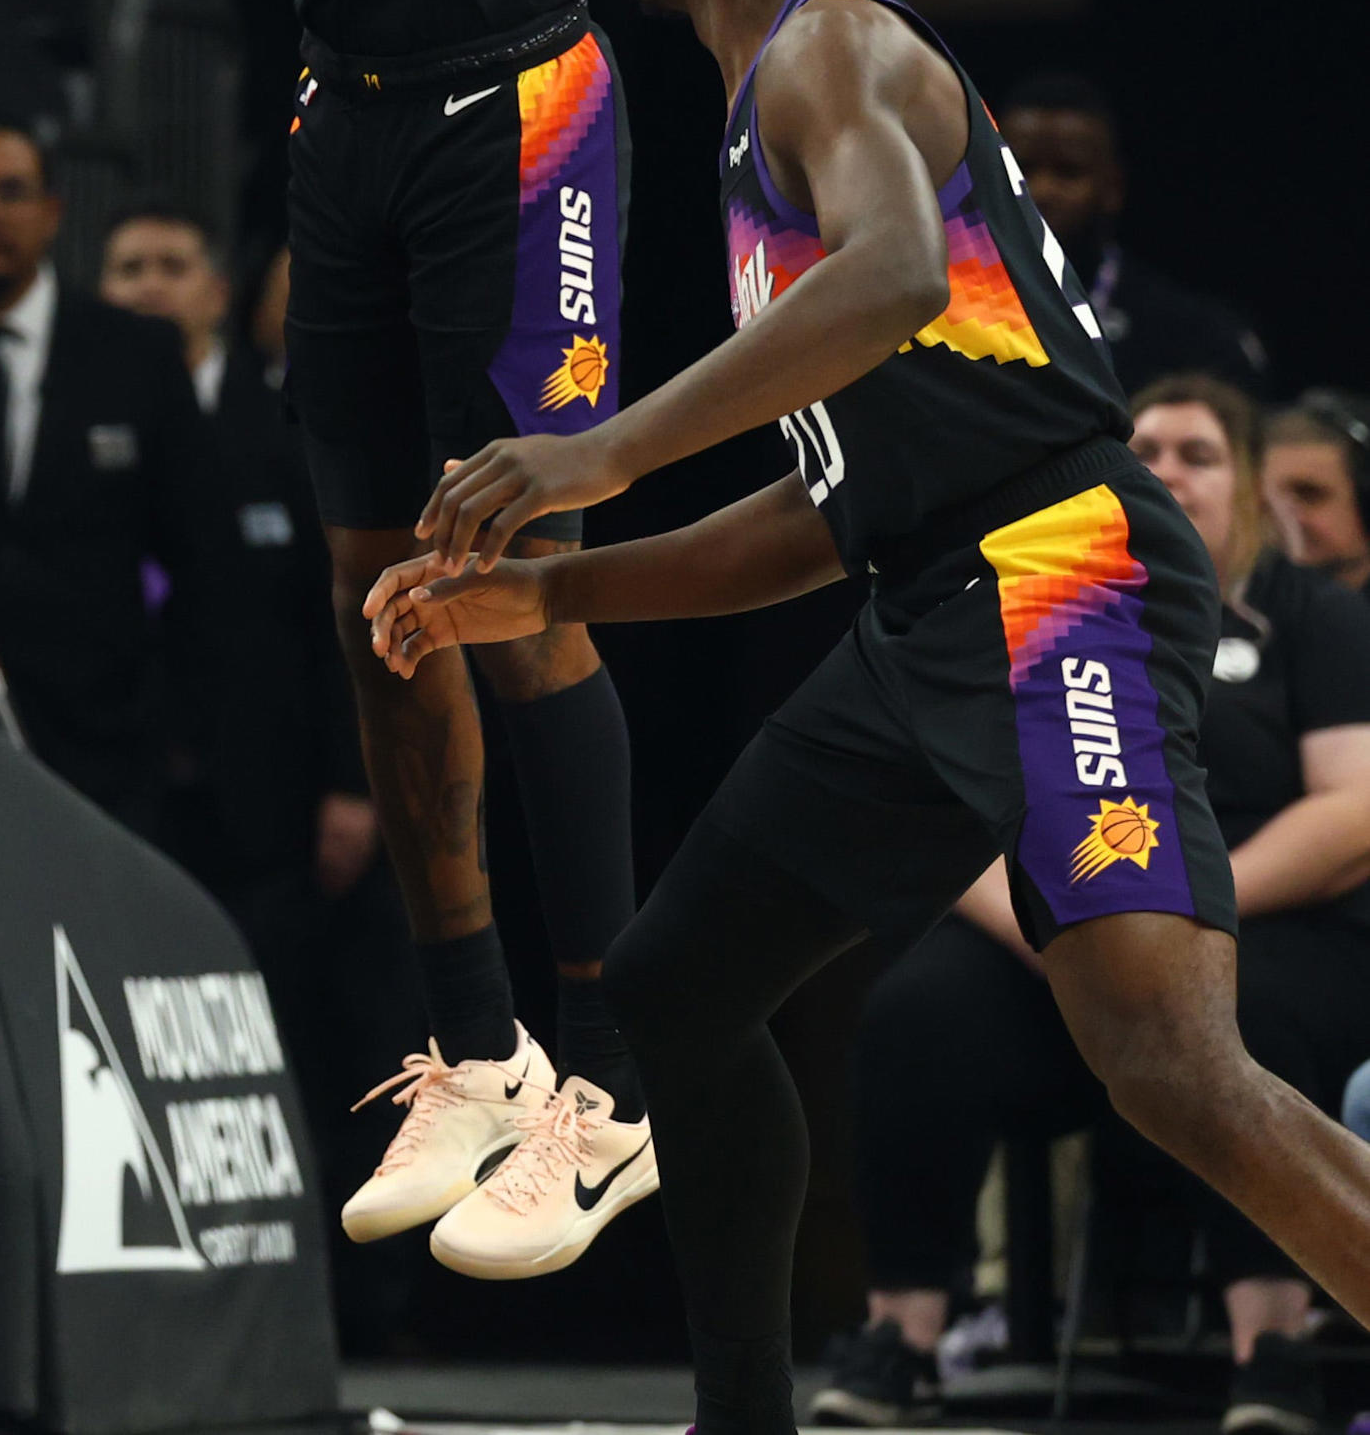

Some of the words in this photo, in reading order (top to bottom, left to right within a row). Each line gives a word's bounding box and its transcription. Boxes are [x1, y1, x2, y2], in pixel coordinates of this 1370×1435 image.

[559, 185, 597, 325] SUNS
[1061, 656, 1128, 788] SUNS
[123, 971, 285, 1082] MOUNTAIN
[165, 1093, 305, 1208] AMERICA
